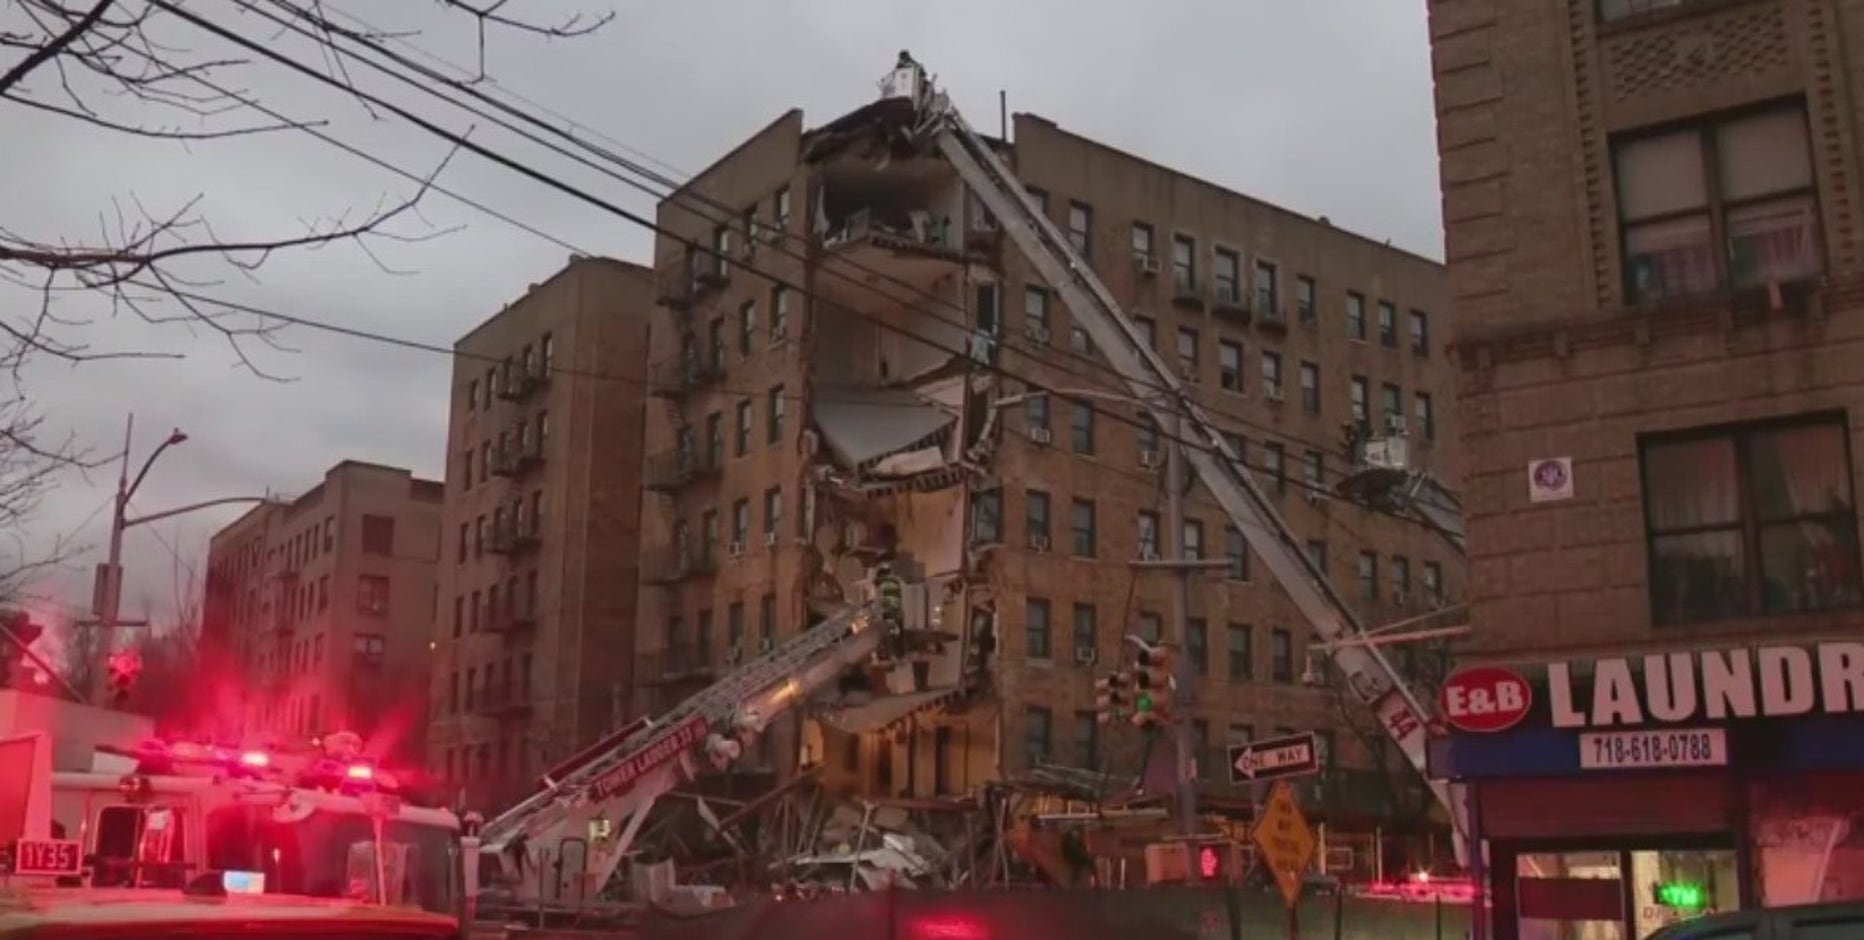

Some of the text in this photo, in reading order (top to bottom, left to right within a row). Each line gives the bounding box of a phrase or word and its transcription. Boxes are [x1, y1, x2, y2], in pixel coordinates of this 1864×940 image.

[1446, 641, 1864, 727] E&B LAUNDR
[1389, 707, 1418, 741] 44
[1241, 744, 1307, 770] ONE WAY
[1593, 733, 1711, 763] 718-618-0788
[594, 762, 638, 797] TOWER
[635, 734, 681, 772] LADDER
[26, 843, 70, 868] 1Y35
